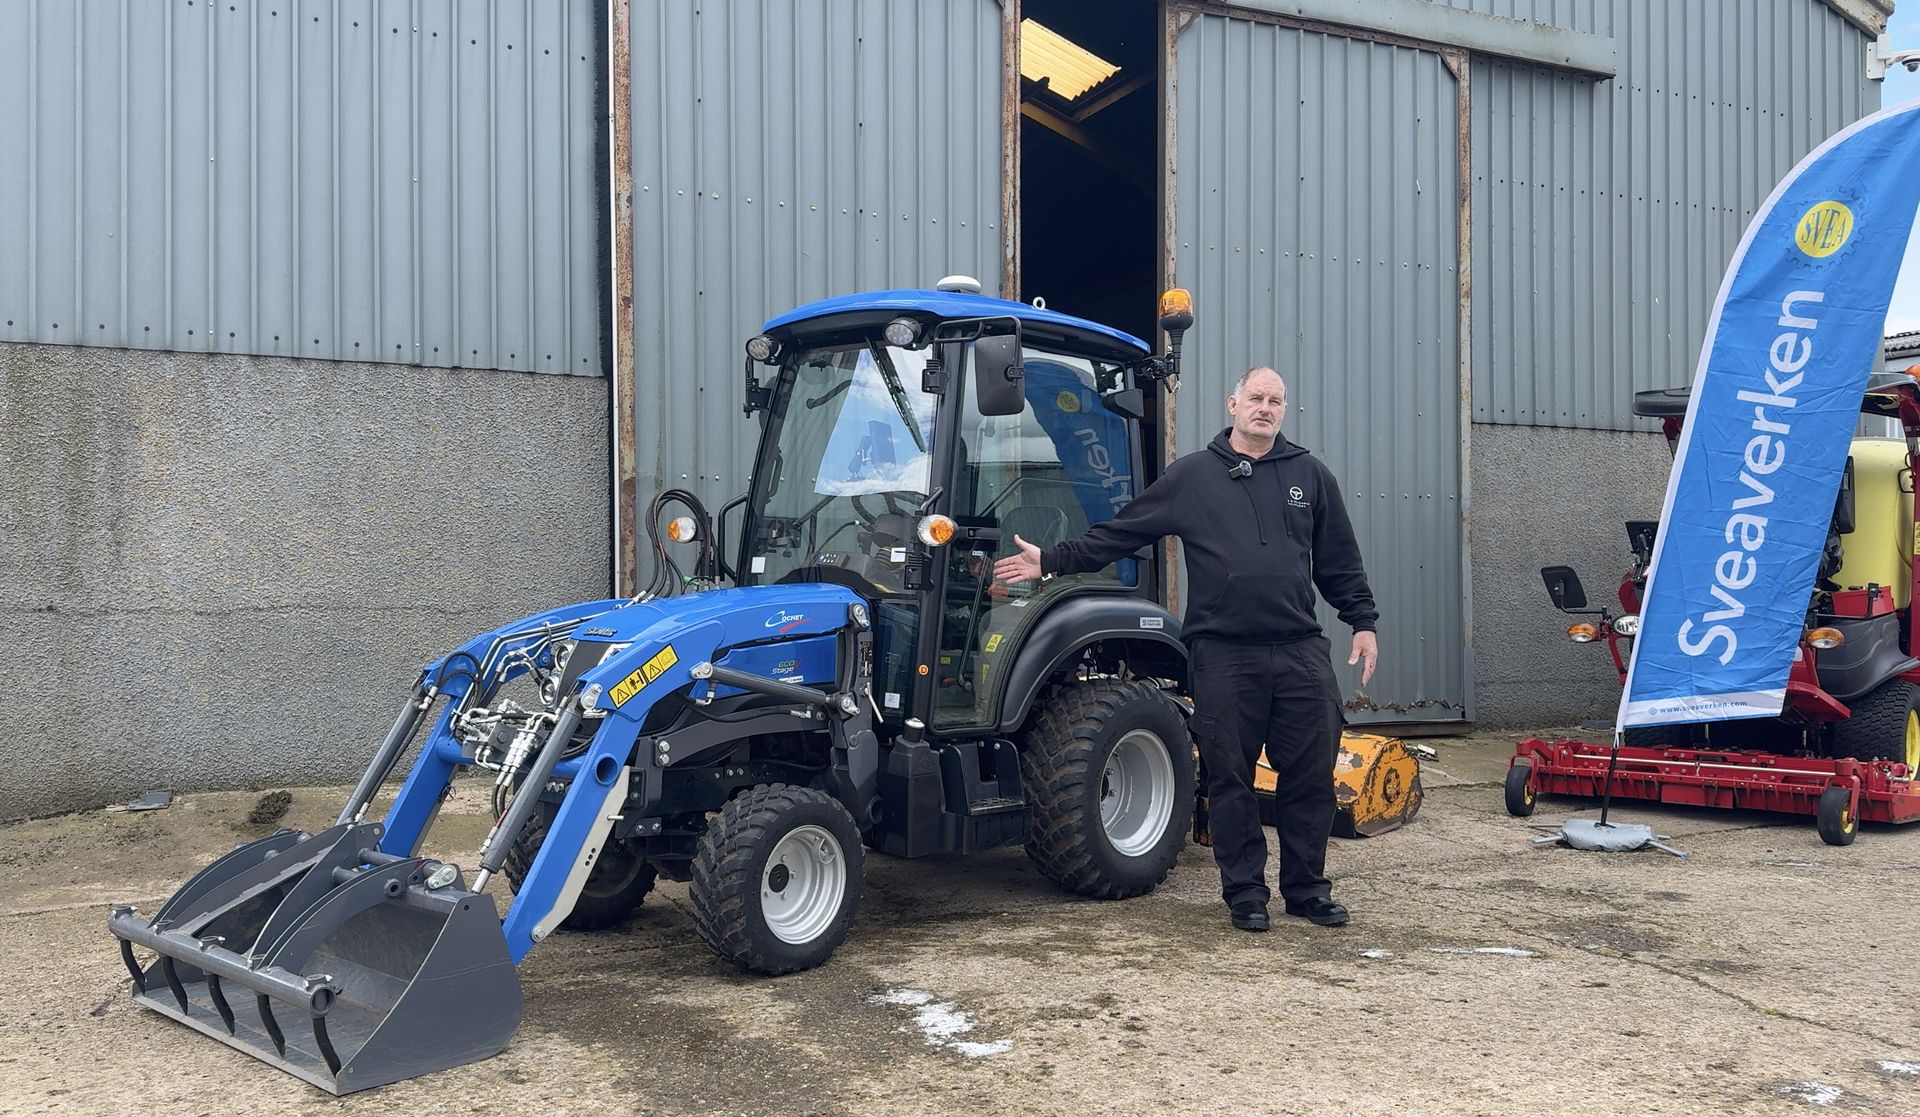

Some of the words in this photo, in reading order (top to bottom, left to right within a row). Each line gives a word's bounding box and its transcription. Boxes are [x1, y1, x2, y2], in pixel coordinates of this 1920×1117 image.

[1801, 208, 1847, 248] SVEA
[1678, 290, 1824, 667] Sveaverken
[764, 610, 804, 628] COCHET
[1660, 701, 1748, 713] www.sveaverken.com
